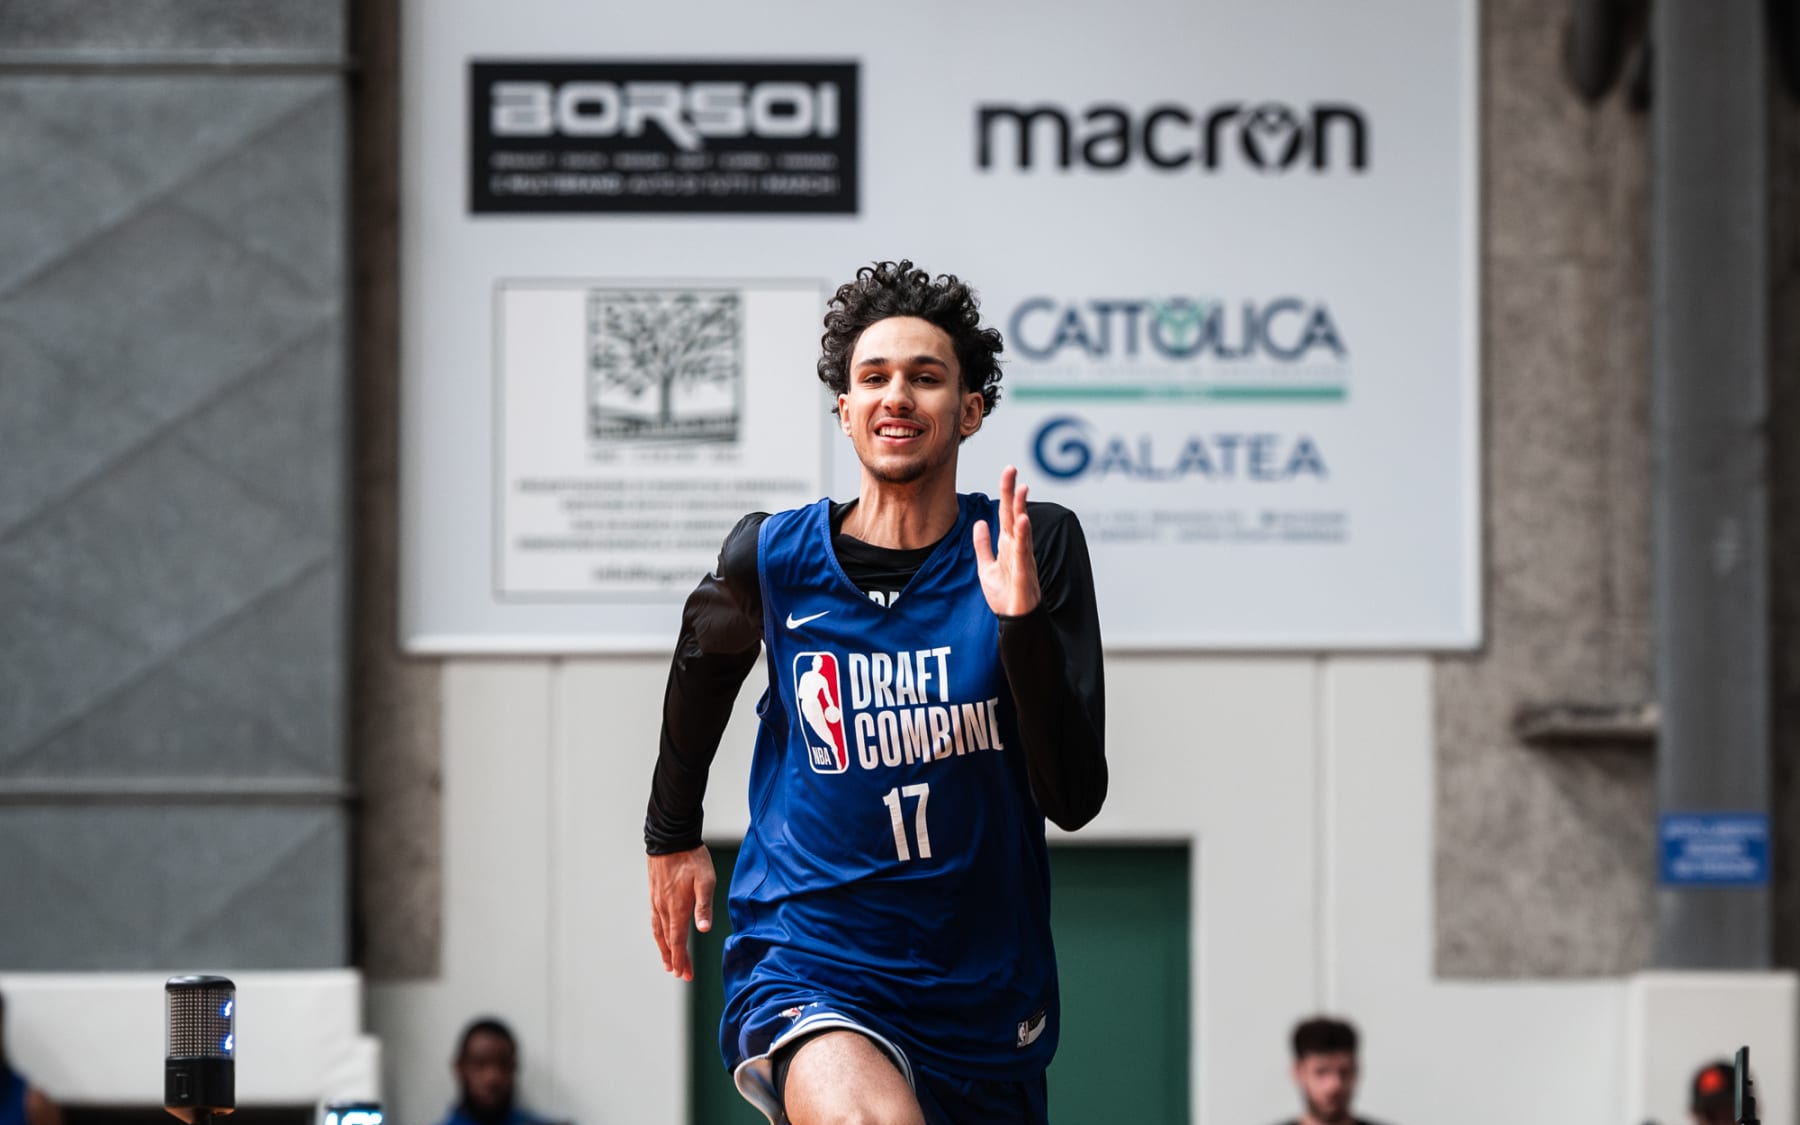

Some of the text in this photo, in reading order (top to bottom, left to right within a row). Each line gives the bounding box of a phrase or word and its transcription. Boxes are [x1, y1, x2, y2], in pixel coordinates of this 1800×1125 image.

[490, 81, 840, 152] BORSOI
[974, 102, 1370, 172] macron
[1008, 298, 1348, 361] CATTOLICA
[1029, 414, 1330, 482] GALATEA
[848, 646, 952, 710] DRAFT
[811, 746, 832, 766] NBA
[882, 782, 932, 862] 17
